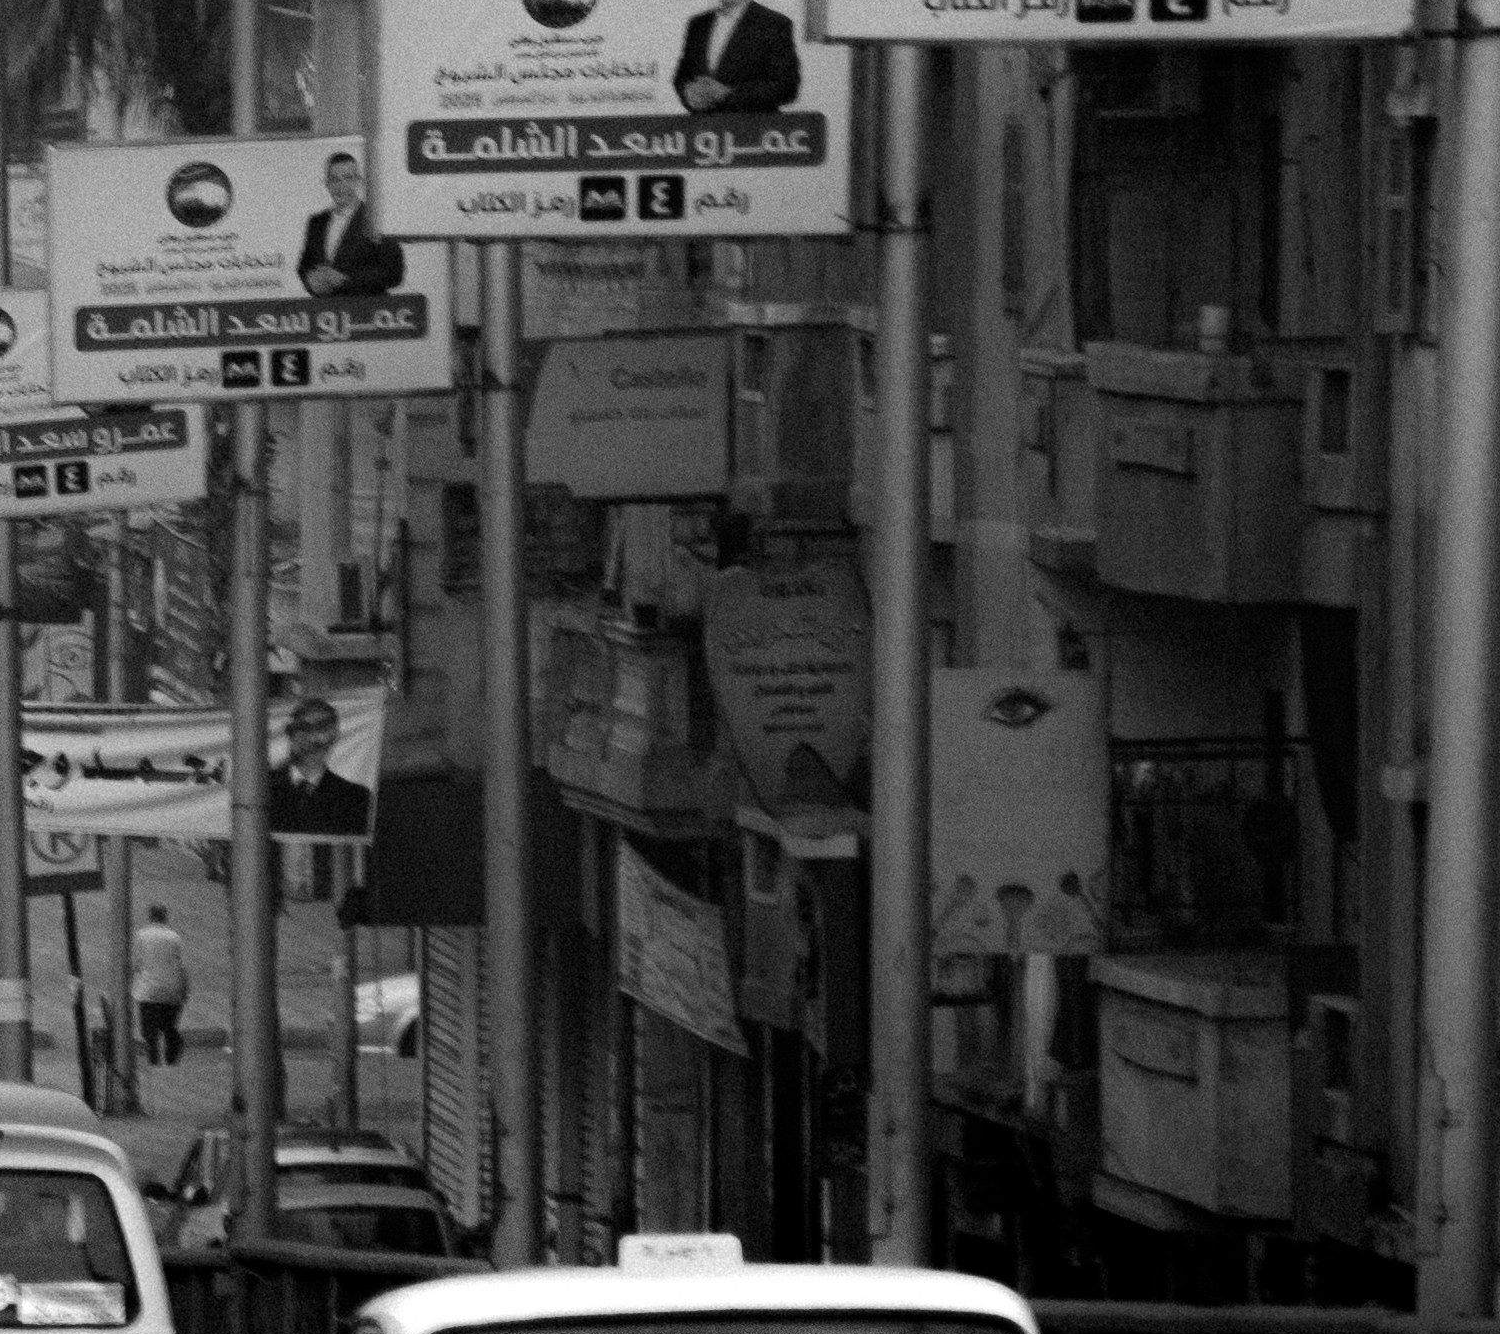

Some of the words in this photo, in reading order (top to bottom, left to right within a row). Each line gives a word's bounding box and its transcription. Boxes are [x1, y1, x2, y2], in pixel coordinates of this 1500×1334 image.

[421, 122, 579, 162] الشلمة
[586, 130, 687, 158] سعد
[694, 130, 812, 167] عمرو
[457, 191, 527, 215] الكتاب
[533, 191, 576, 219] رمز
[651, 180, 672, 215] ٤
[694, 187, 750, 215] رقم
[227, 311, 311, 335] سعد
[316, 308, 416, 342] عمرو
[282, 354, 300, 381] ٤
[16, 429, 89, 452] سعد
[91, 422, 178, 456] عمرو
